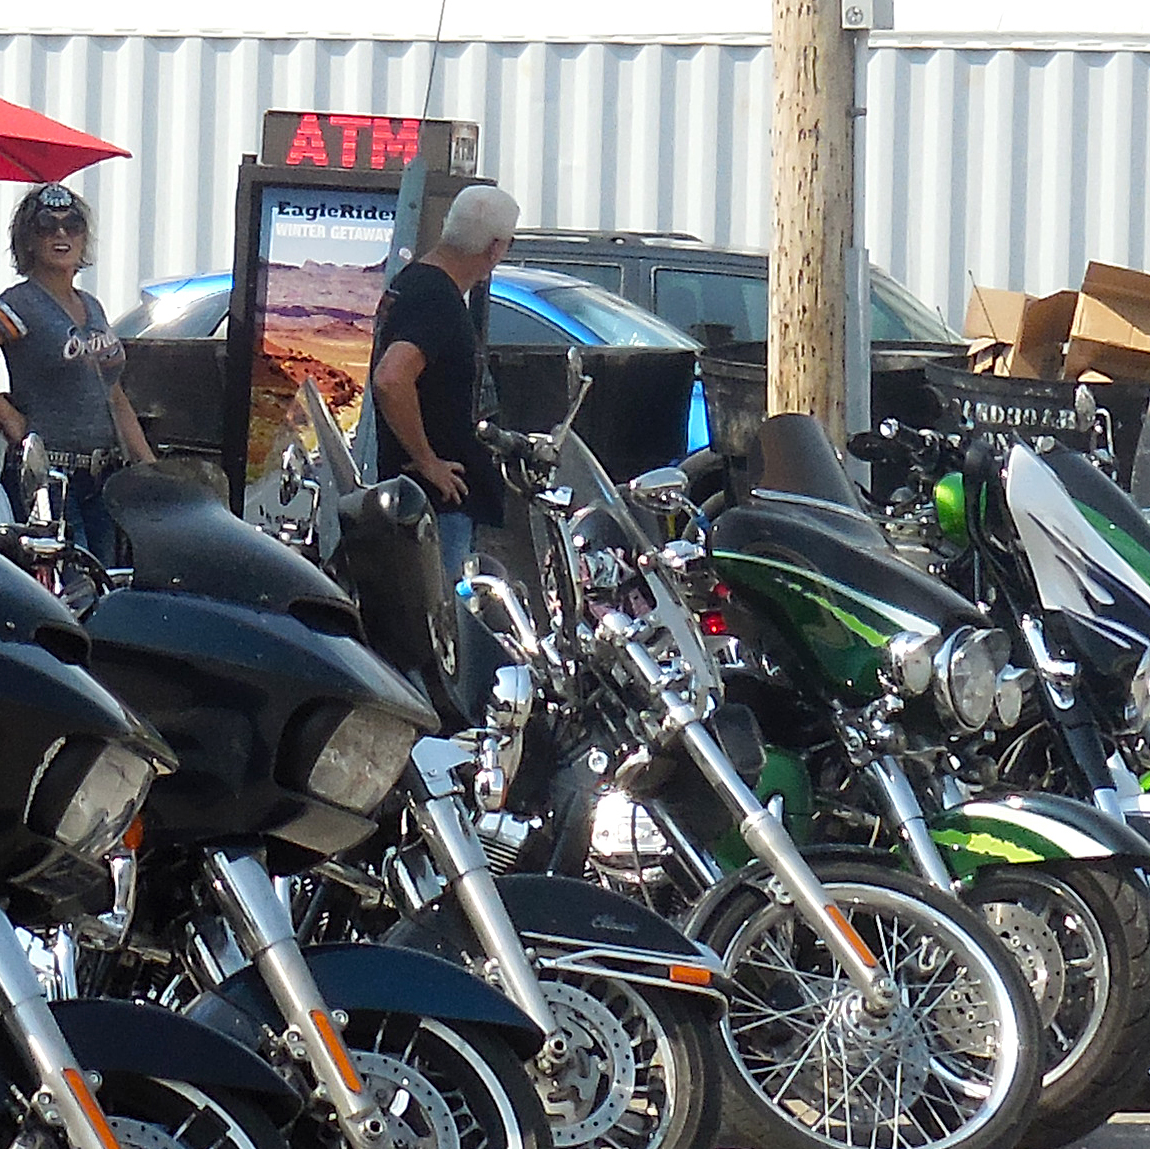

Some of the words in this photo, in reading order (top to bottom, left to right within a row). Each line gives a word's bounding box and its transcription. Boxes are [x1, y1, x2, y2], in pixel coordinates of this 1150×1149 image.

[285, 114, 420, 169] ATM
[275, 222, 325, 238] WINTER
[330, 225, 394, 242] GETAWAY
